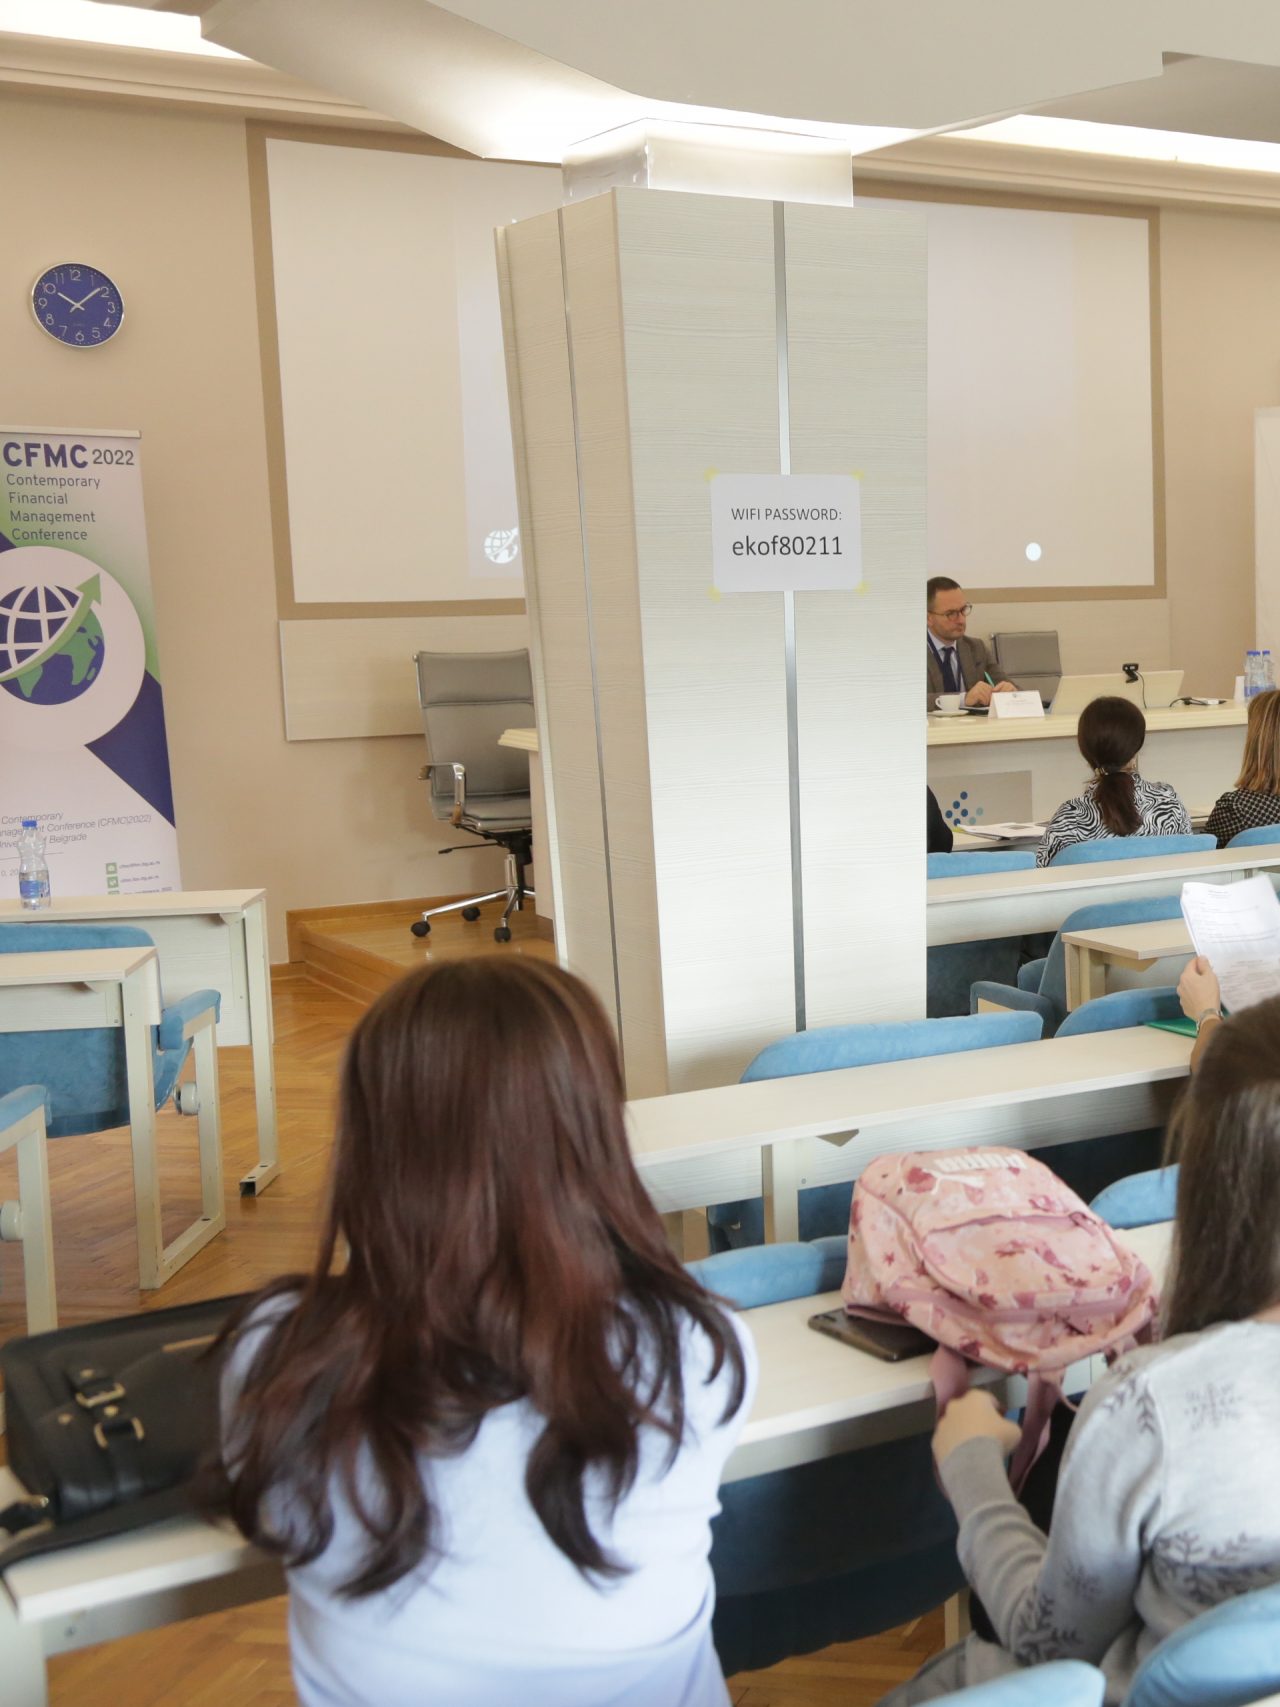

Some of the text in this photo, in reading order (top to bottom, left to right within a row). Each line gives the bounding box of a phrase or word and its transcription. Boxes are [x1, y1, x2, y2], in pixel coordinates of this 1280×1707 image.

[54, 272, 64, 284] 11
[69, 269, 81, 281] 12
[100, 286, 110, 297] 2
[38, 297, 48, 309] 9
[107, 301, 116, 313] 3
[45, 313, 55, 326] 8
[103, 318, 112, 327] 4
[59, 325, 68, 336] 7
[75, 331, 85, 341] 6
[92, 327, 101, 338] 5
[2, 441, 135, 469] CFMC 2022
[6, 473, 101, 490] Contemporary
[9, 492, 68, 505] Financial
[10, 510, 96, 525] Management
[731, 508, 842, 521] WIFI PASSWORD:
[12, 528, 88, 541] Conference
[732, 535, 843, 556] ekof80211
[47, 819, 96, 832] Conference
[49, 833, 88, 845] Belgrade
